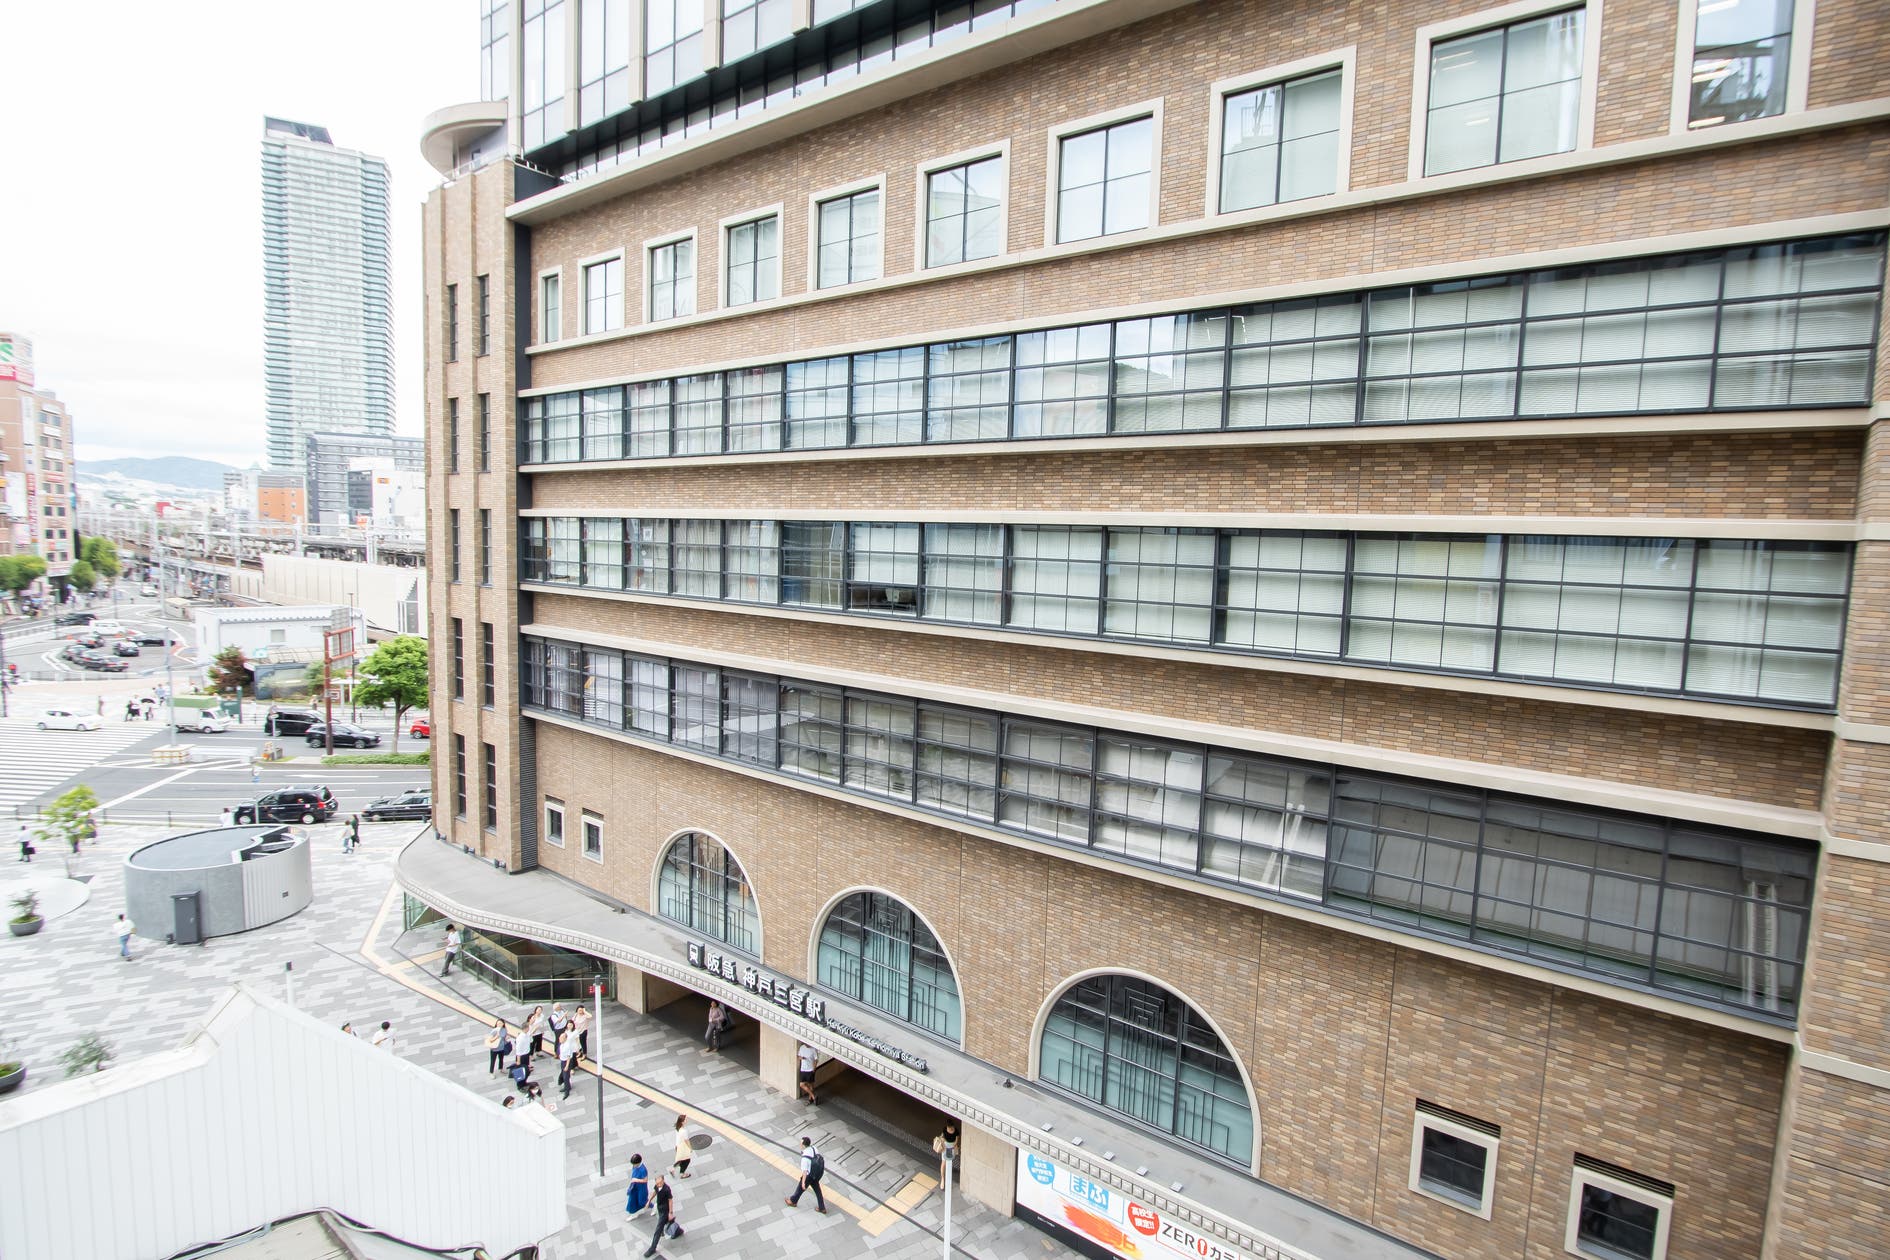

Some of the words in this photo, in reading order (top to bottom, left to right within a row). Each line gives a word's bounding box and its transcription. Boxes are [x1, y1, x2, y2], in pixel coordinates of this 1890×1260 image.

[707, 952, 735, 981] 阪急
[743, 966, 821, 1021] 神戸三宮駅
